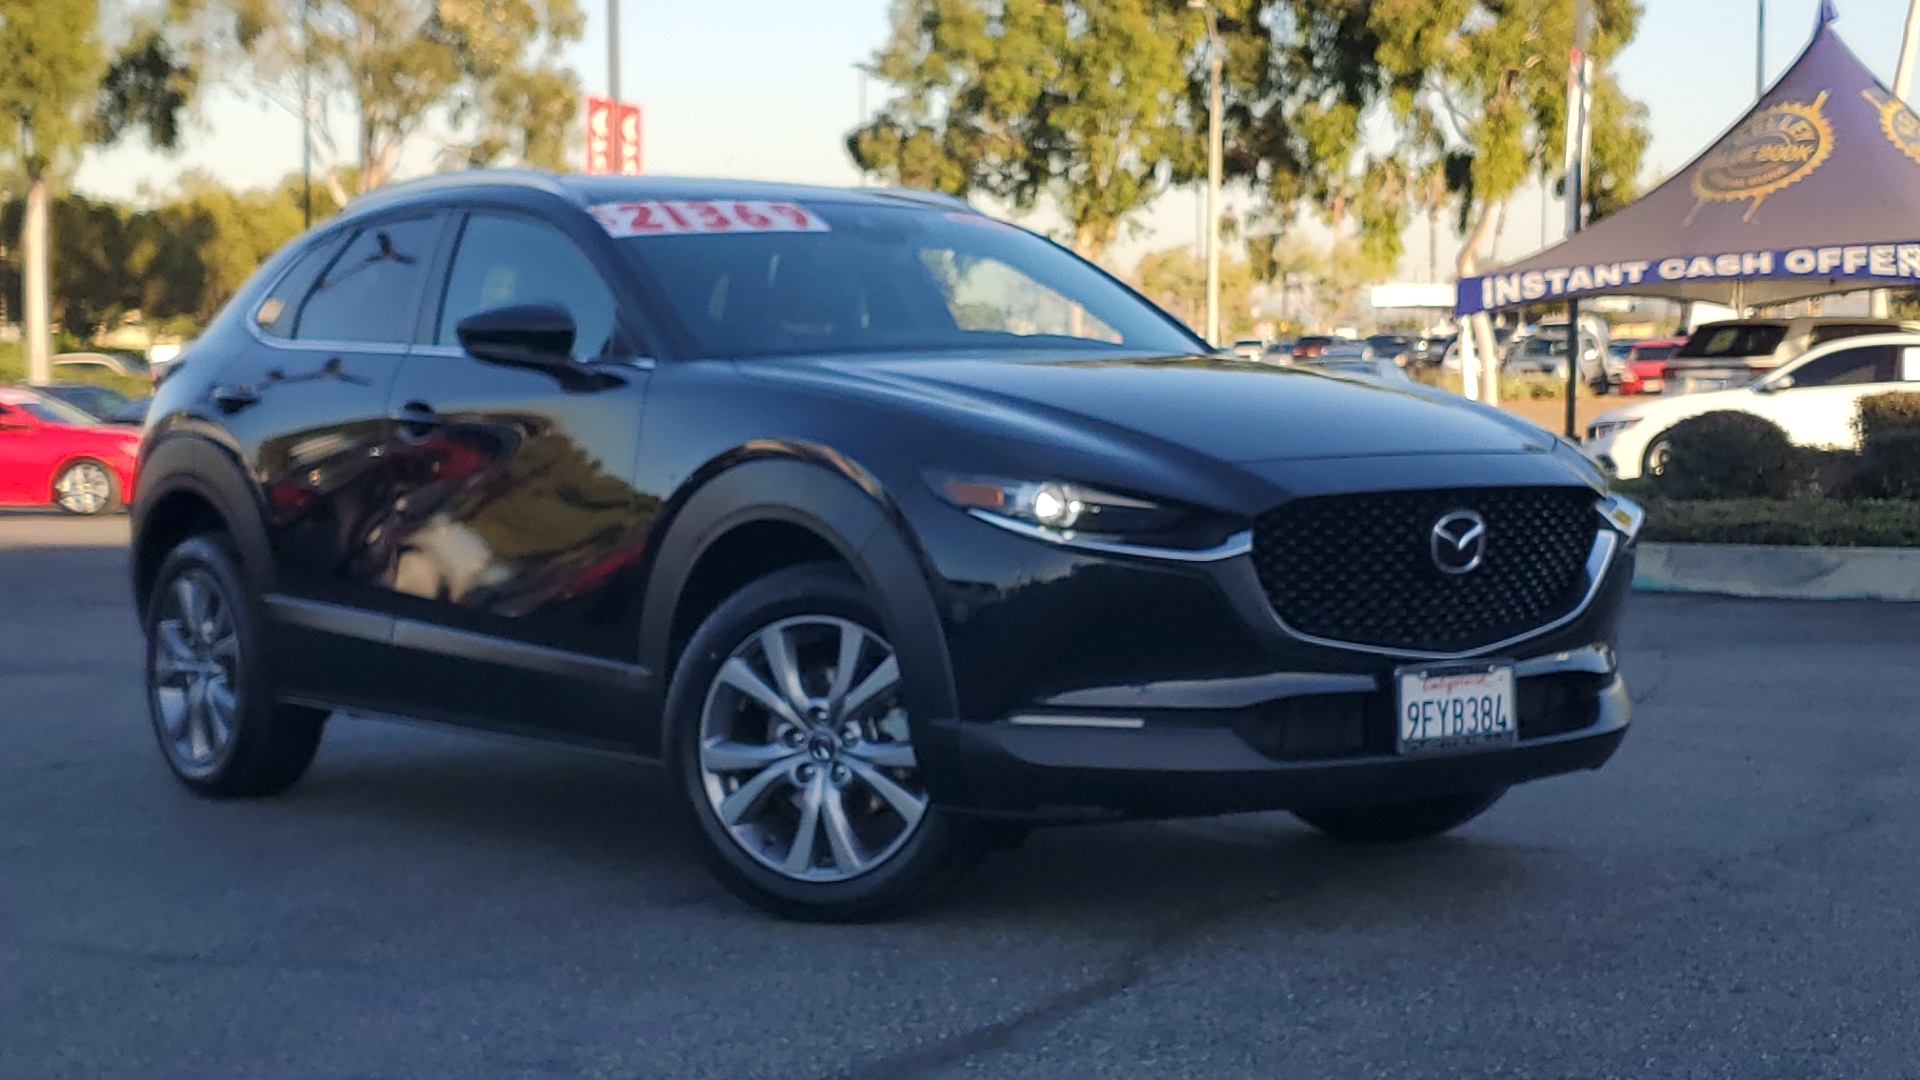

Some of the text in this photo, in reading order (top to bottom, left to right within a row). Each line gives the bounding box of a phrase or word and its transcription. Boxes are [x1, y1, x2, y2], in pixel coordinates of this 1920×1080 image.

[1482, 261, 1649, 309] INSTANT
[1658, 251, 1773, 281] CASH
[1407, 694, 1507, 739] 9FYB384
